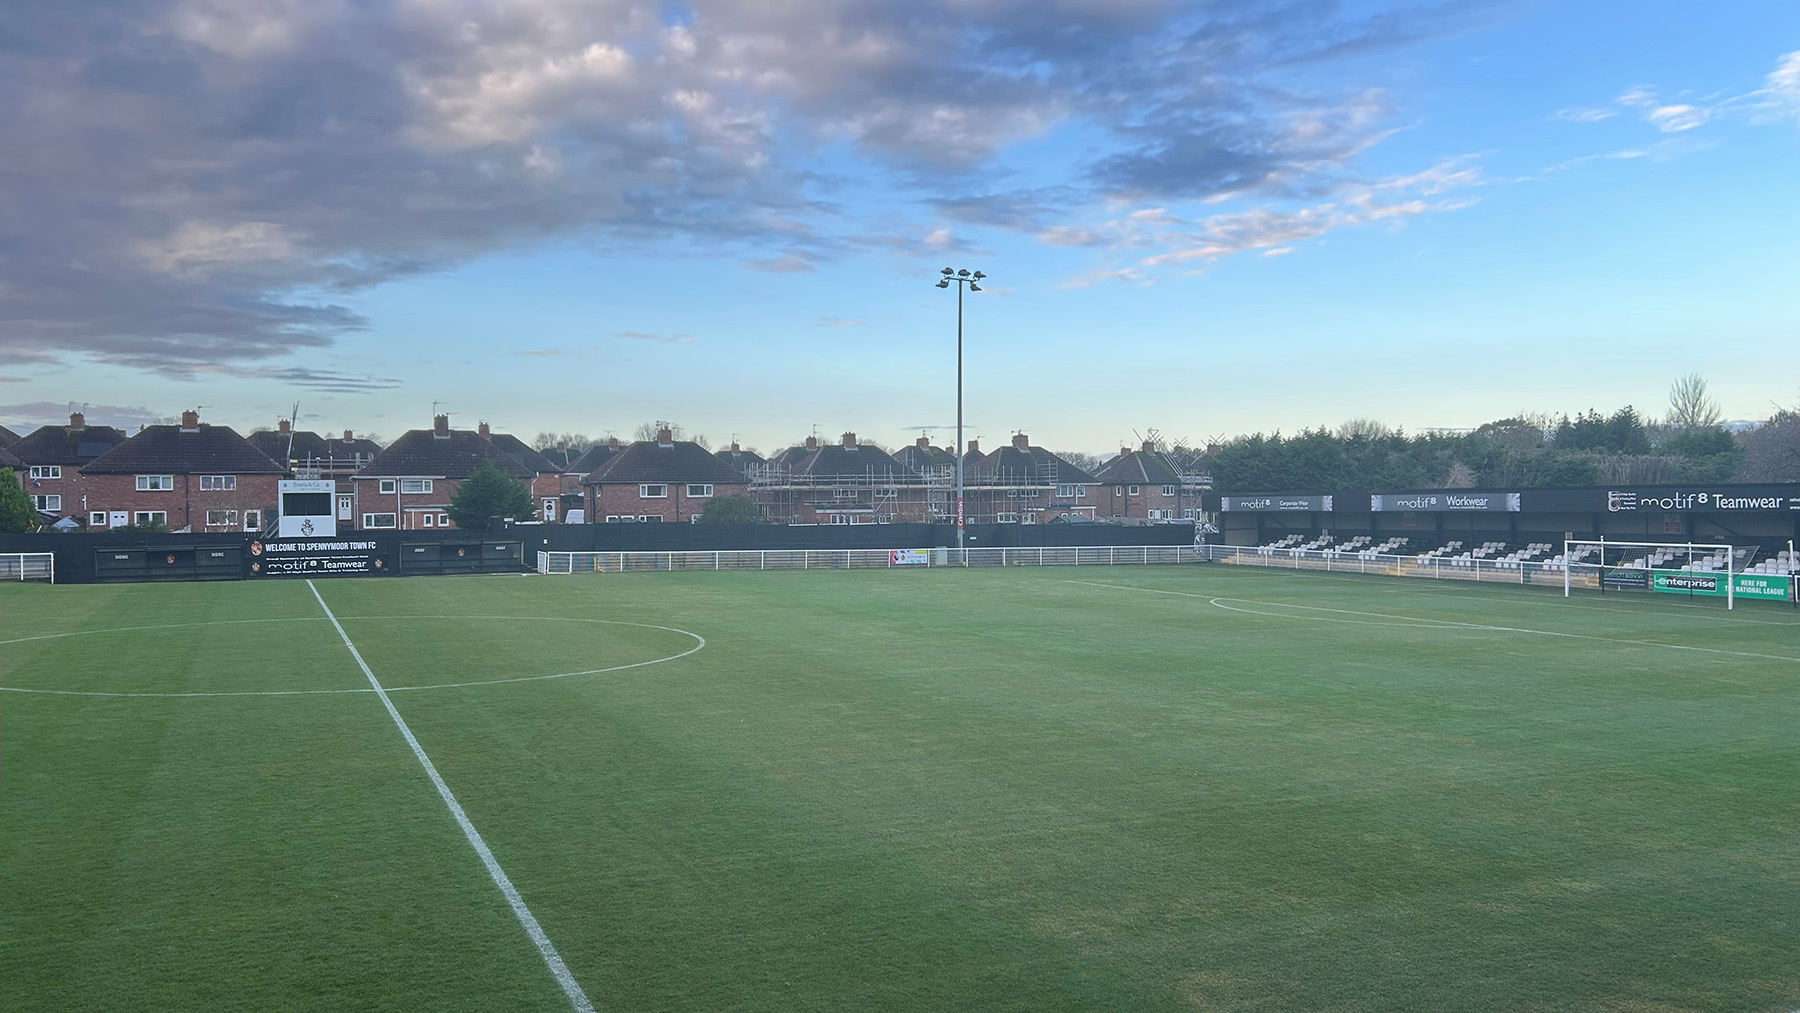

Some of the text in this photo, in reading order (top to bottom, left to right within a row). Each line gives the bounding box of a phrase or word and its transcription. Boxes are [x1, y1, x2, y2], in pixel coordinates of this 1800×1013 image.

[1446, 495, 1489, 506] Workwear
[1713, 493, 1784, 509] Teamwear
[265, 541, 377, 552] WELCOME TO SPENNYMOOR TOWN FC
[321, 560, 367, 569] Teamwear
[1656, 577, 1715, 588] enterprise
[1740, 579, 1755, 587] HERE
[1735, 586, 1762, 594] NATIONAL
[1763, 588, 1785, 596] LEAGUE
